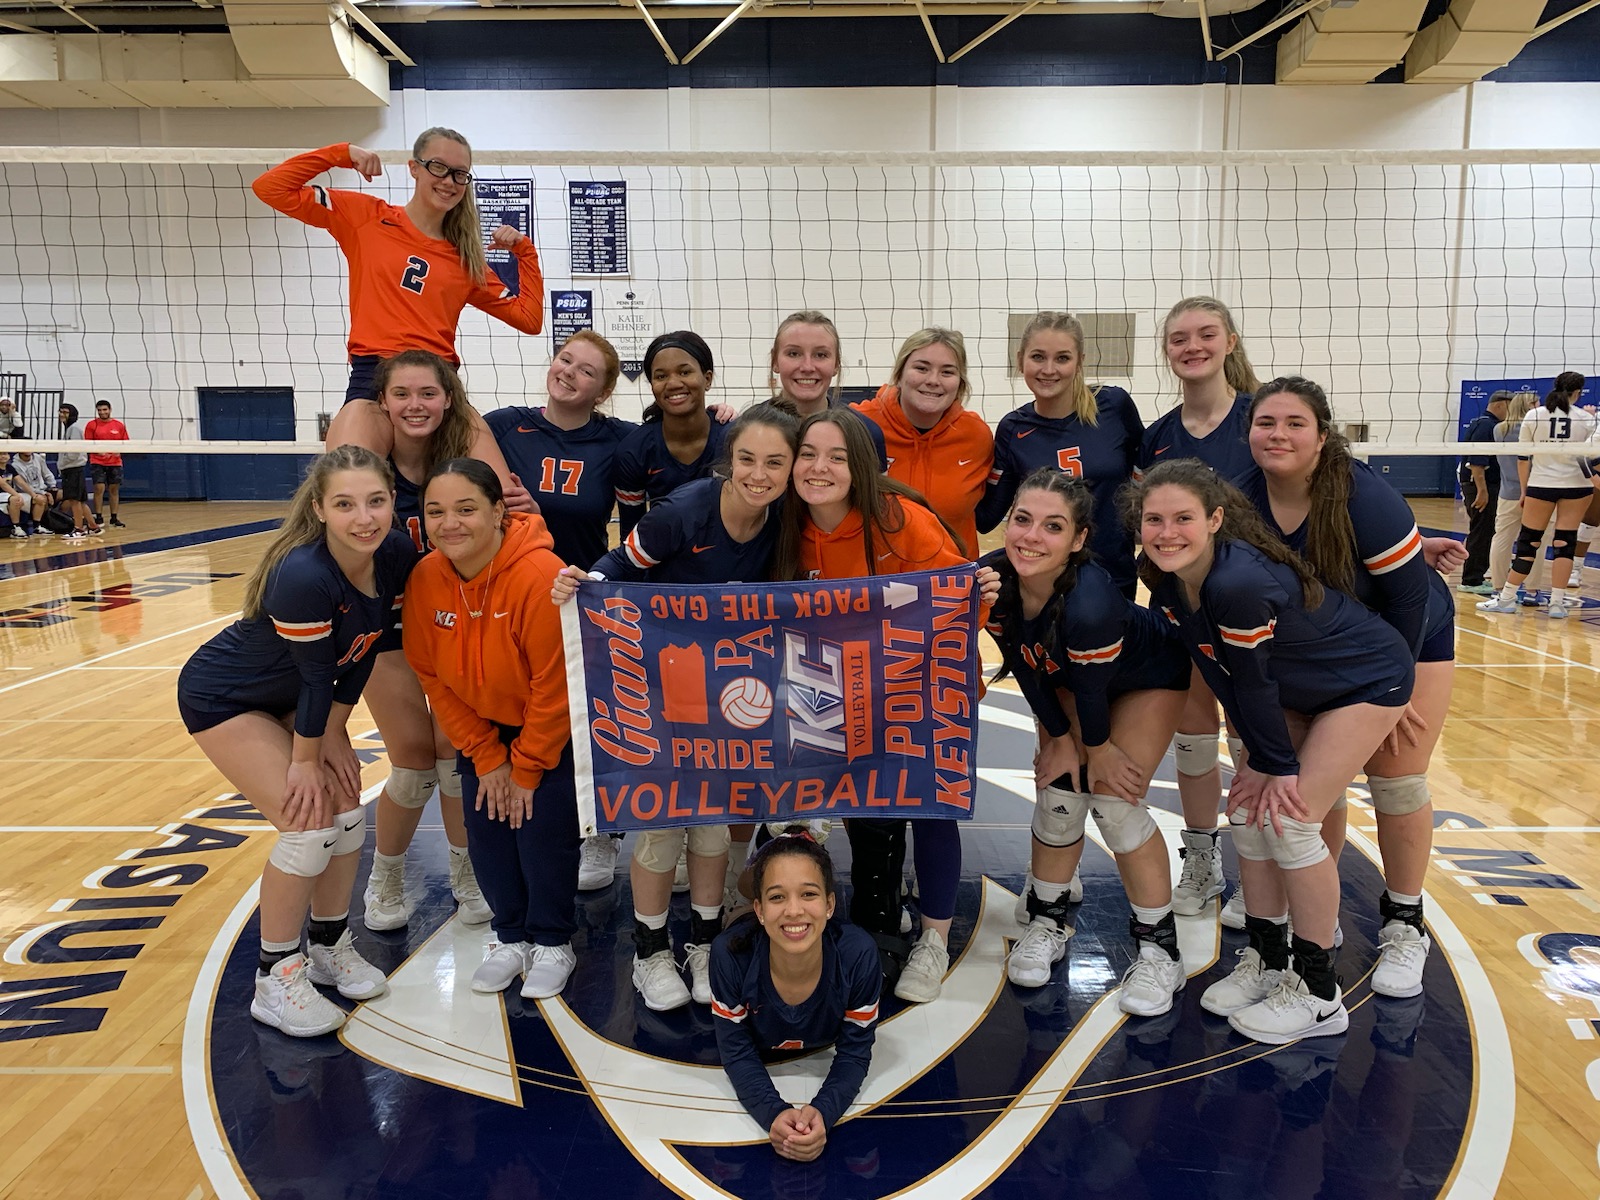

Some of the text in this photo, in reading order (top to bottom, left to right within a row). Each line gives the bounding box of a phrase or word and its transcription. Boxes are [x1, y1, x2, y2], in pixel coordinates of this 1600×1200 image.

[400, 255, 430, 296] 2
[556, 299, 588, 308] PSUAC
[618, 315, 644, 323] KATIE
[611, 323, 652, 332] BEHNERT
[623, 363, 642, 372] 2015
[1549, 417, 1572, 439] 13
[539, 457, 584, 496] 17
[1057, 446, 1084, 480] 5
[433, 609, 457, 629] KC
[650, 587, 871, 621] PACK THE GAC
[715, 625, 774, 671] PA
[584, 597, 661, 766] Giants
[882, 619, 926, 760] POINT
[929, 574, 974, 812] KEYSTONE
[851, 650, 866, 748] VOLLEYBALL
[672, 737, 774, 769] PRIDE
[597, 769, 923, 823] VOLLEYBALL
